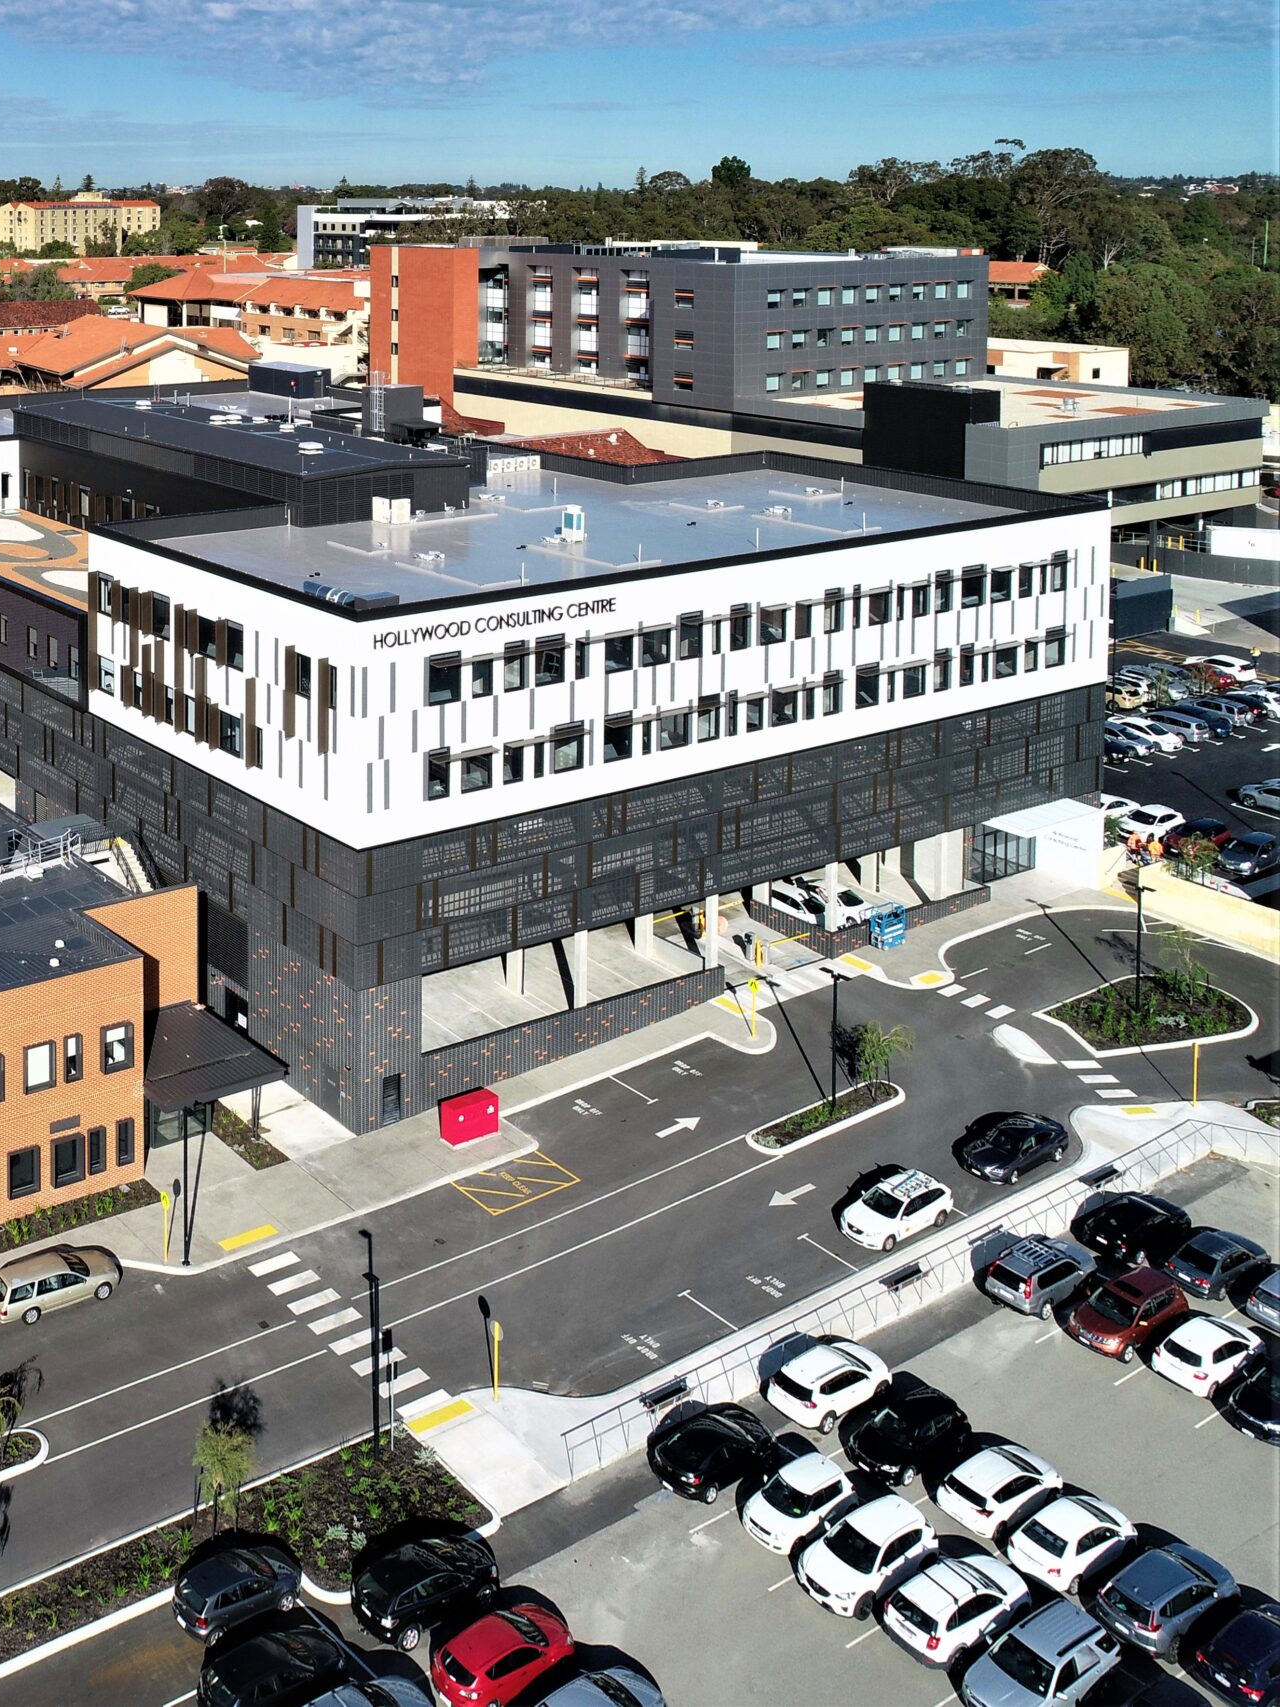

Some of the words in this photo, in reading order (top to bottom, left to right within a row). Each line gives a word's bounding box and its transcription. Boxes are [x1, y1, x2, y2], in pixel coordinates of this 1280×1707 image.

[373, 620, 471, 650] HOLLYWOOD
[474, 606, 563, 633] CONSULTING
[566, 597, 617, 619] CENTRE
[499, 1171, 516, 1182] KEEP
[512, 1181, 533, 1195] CLEAR
[639, 1333, 661, 1349] ONLY
[636, 1345, 658, 1360] DROP
